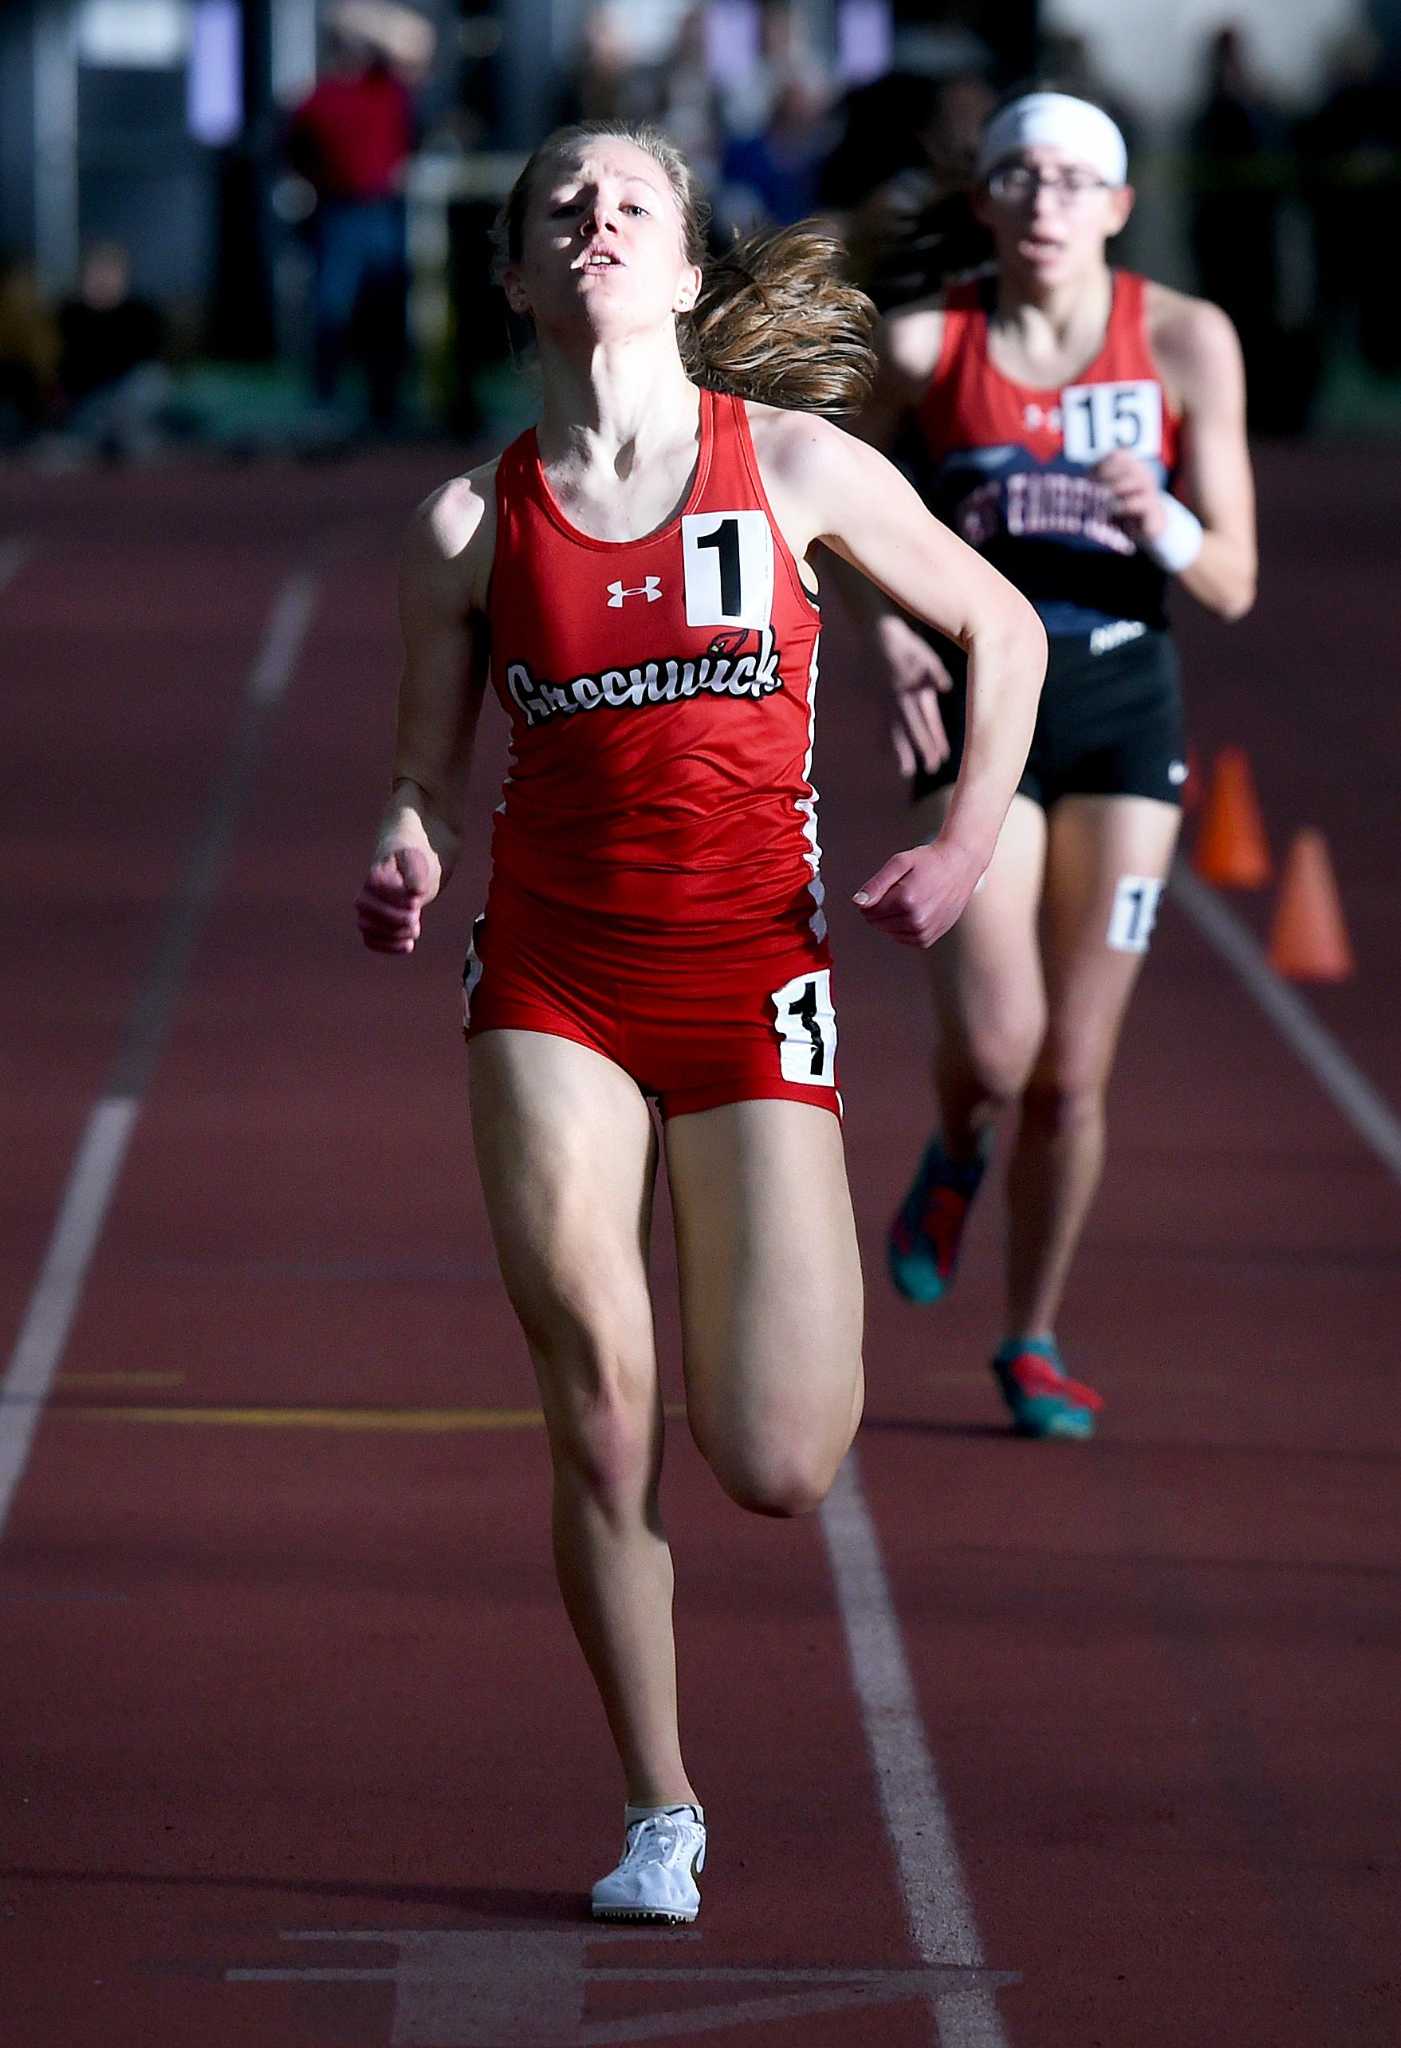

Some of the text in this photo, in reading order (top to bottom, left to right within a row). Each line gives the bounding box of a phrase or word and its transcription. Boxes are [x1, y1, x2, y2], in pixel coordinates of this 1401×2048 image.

[1075, 388, 1142, 452] 15
[696, 518, 743, 617] 1
[506, 629, 783, 726] Greenwich
[788, 981, 824, 1076] 1
